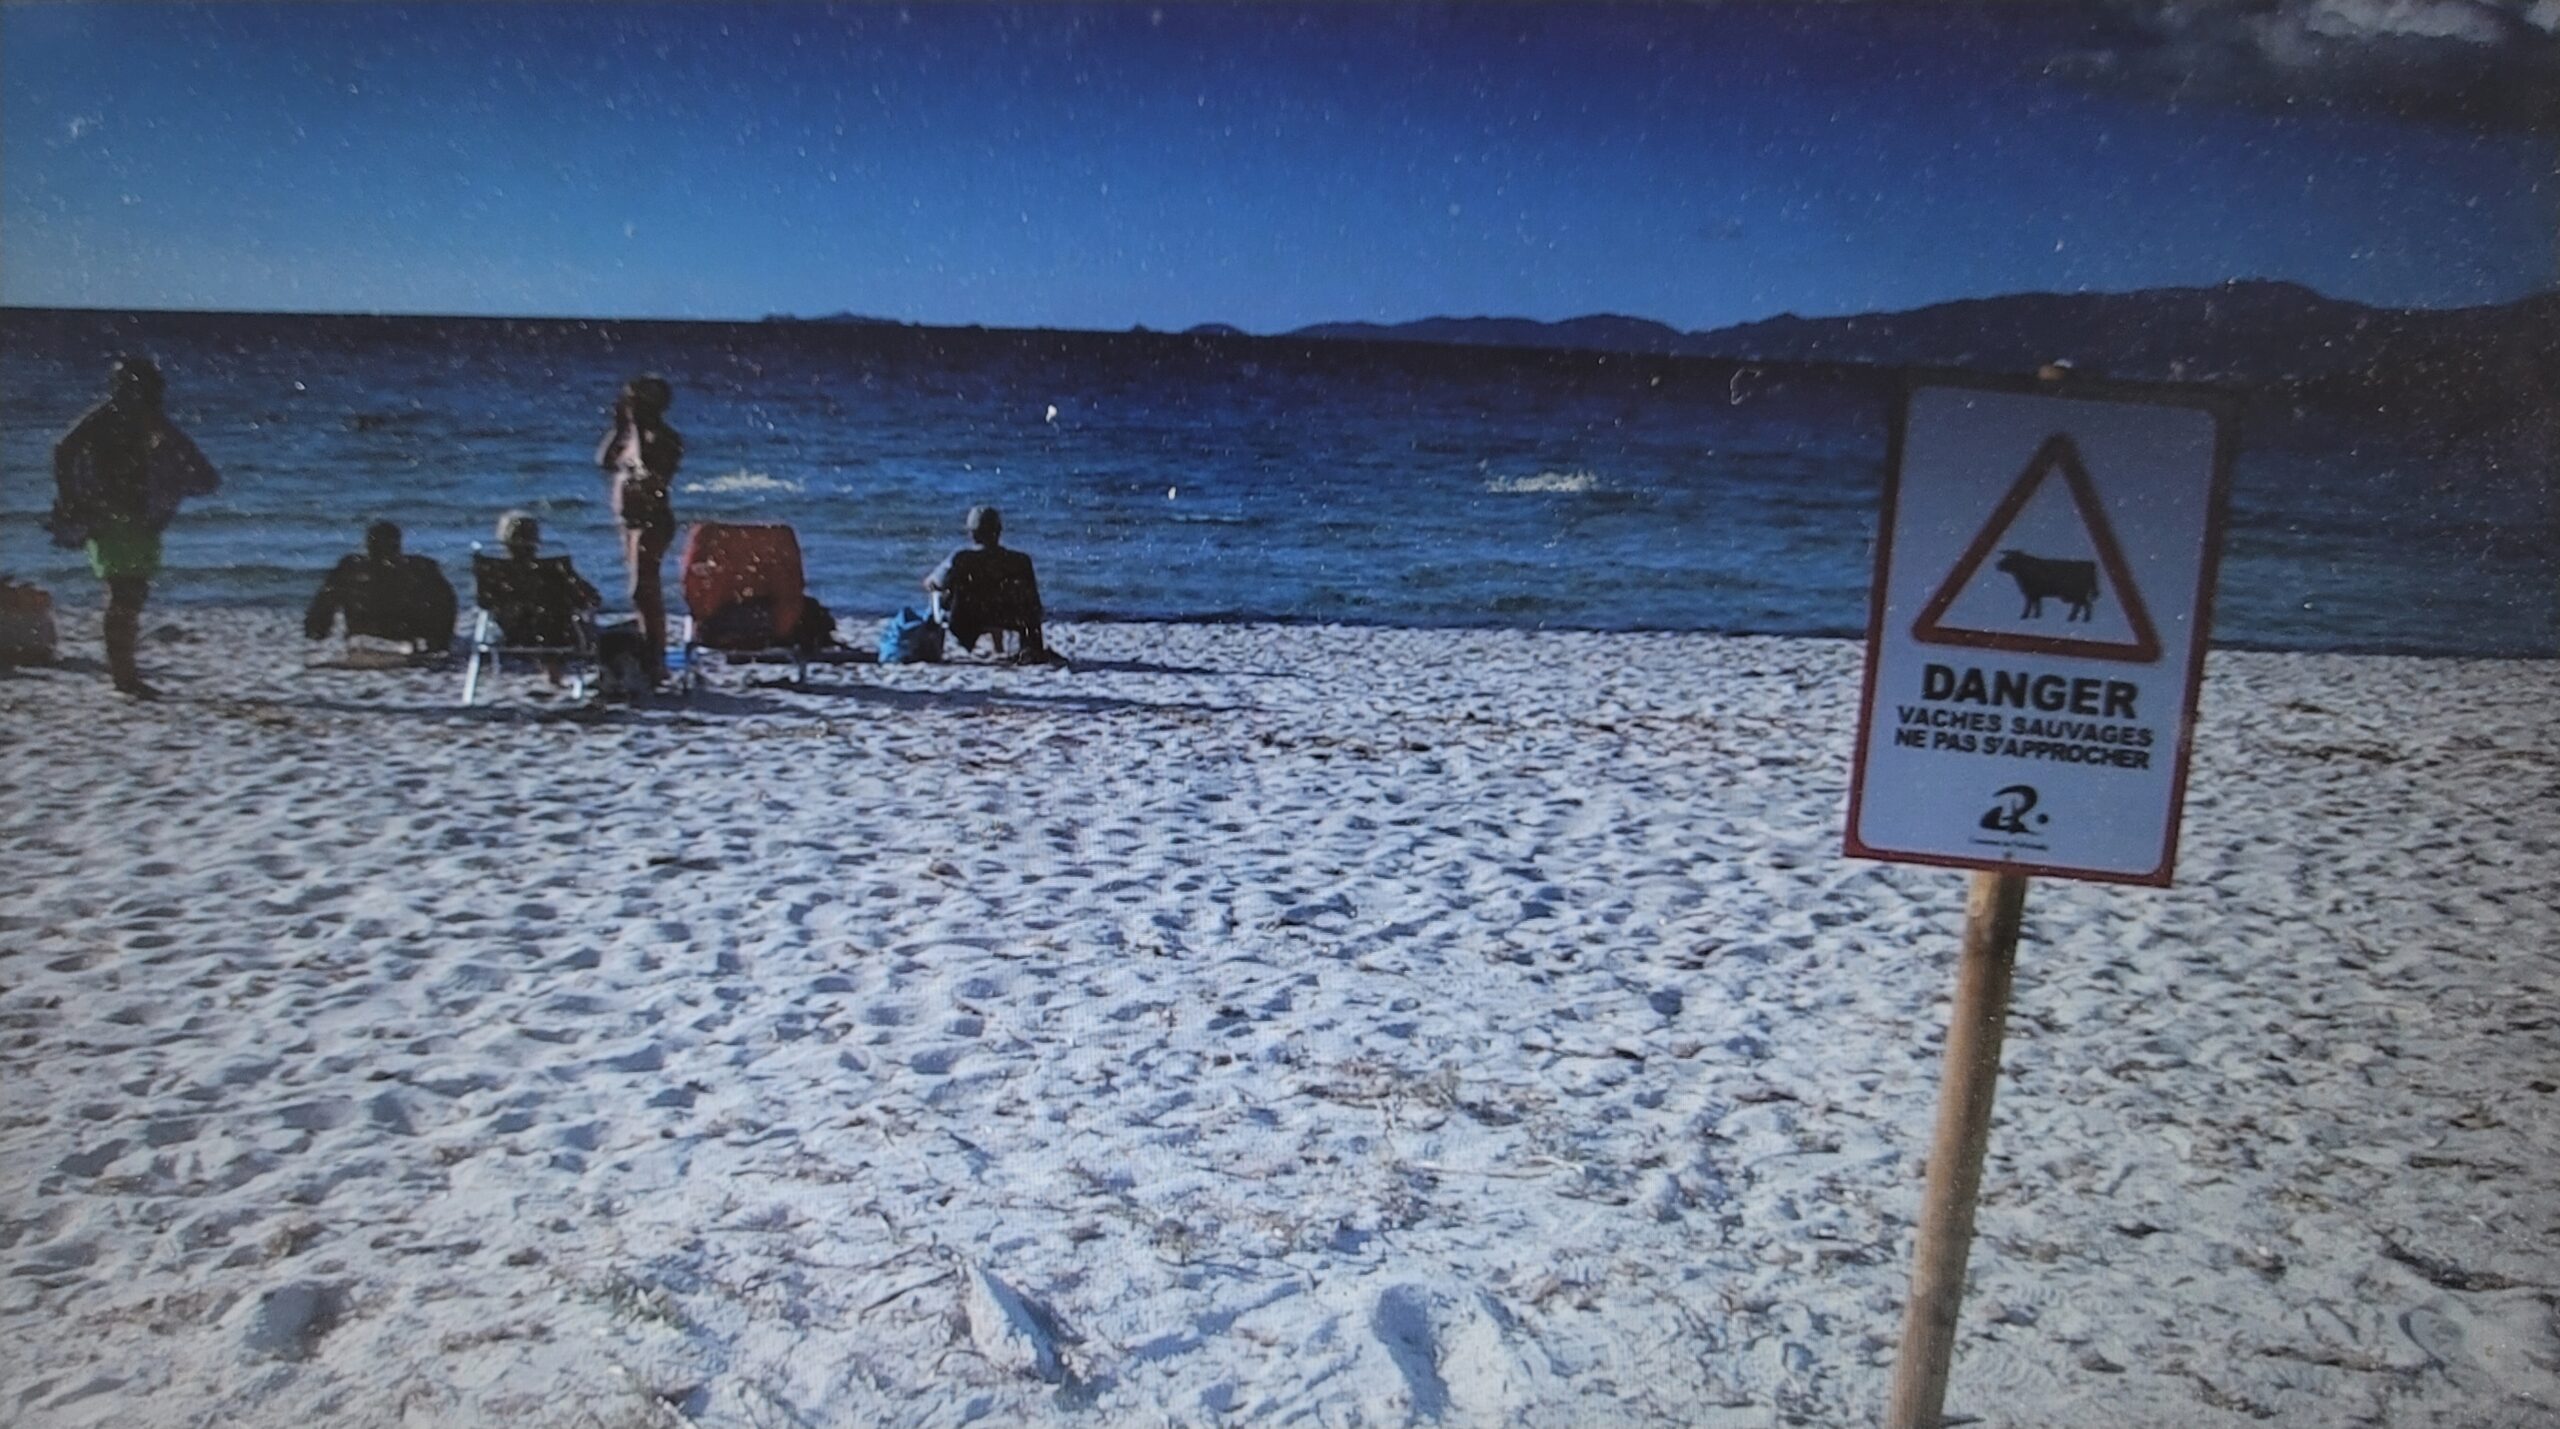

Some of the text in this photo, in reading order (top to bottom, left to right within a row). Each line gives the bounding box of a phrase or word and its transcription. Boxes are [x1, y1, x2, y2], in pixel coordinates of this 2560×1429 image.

[1922, 664, 2138, 719] DANGER
[1897, 705, 2154, 747] VACHES SAUVAGES
[1894, 727, 2150, 769] NE PAS S'APPROCHER
